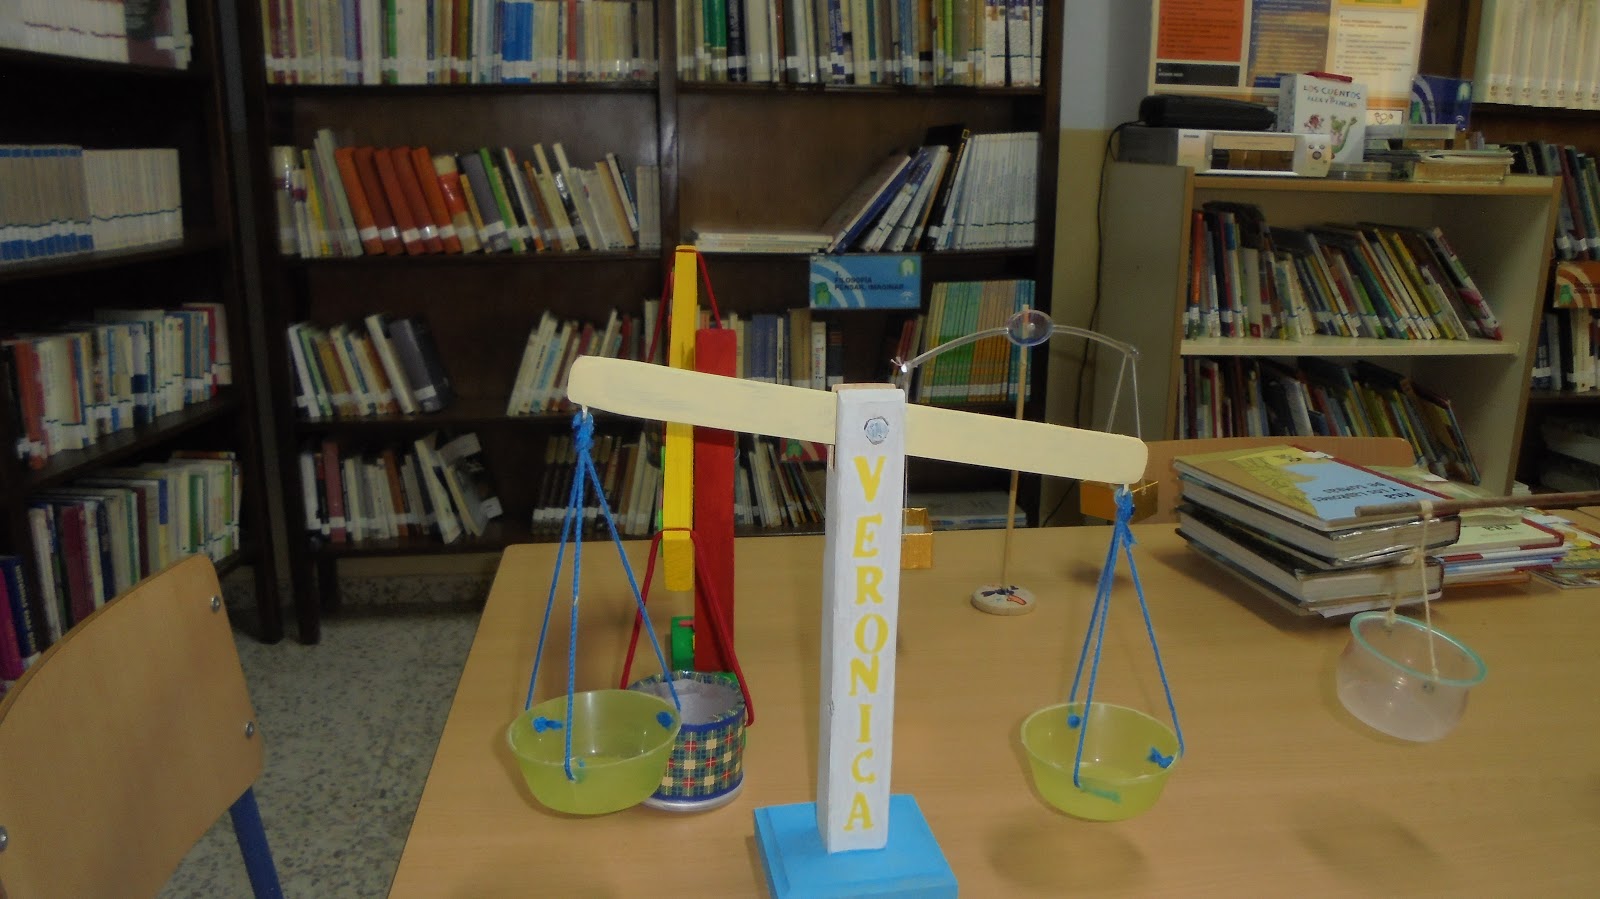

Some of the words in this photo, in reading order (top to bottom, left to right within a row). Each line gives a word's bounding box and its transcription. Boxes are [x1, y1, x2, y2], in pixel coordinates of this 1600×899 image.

[1303, 85, 1319, 93] LOS
[1321, 87, 1361, 100] CUENTOS
[843, 455, 889, 831] VERONICA
